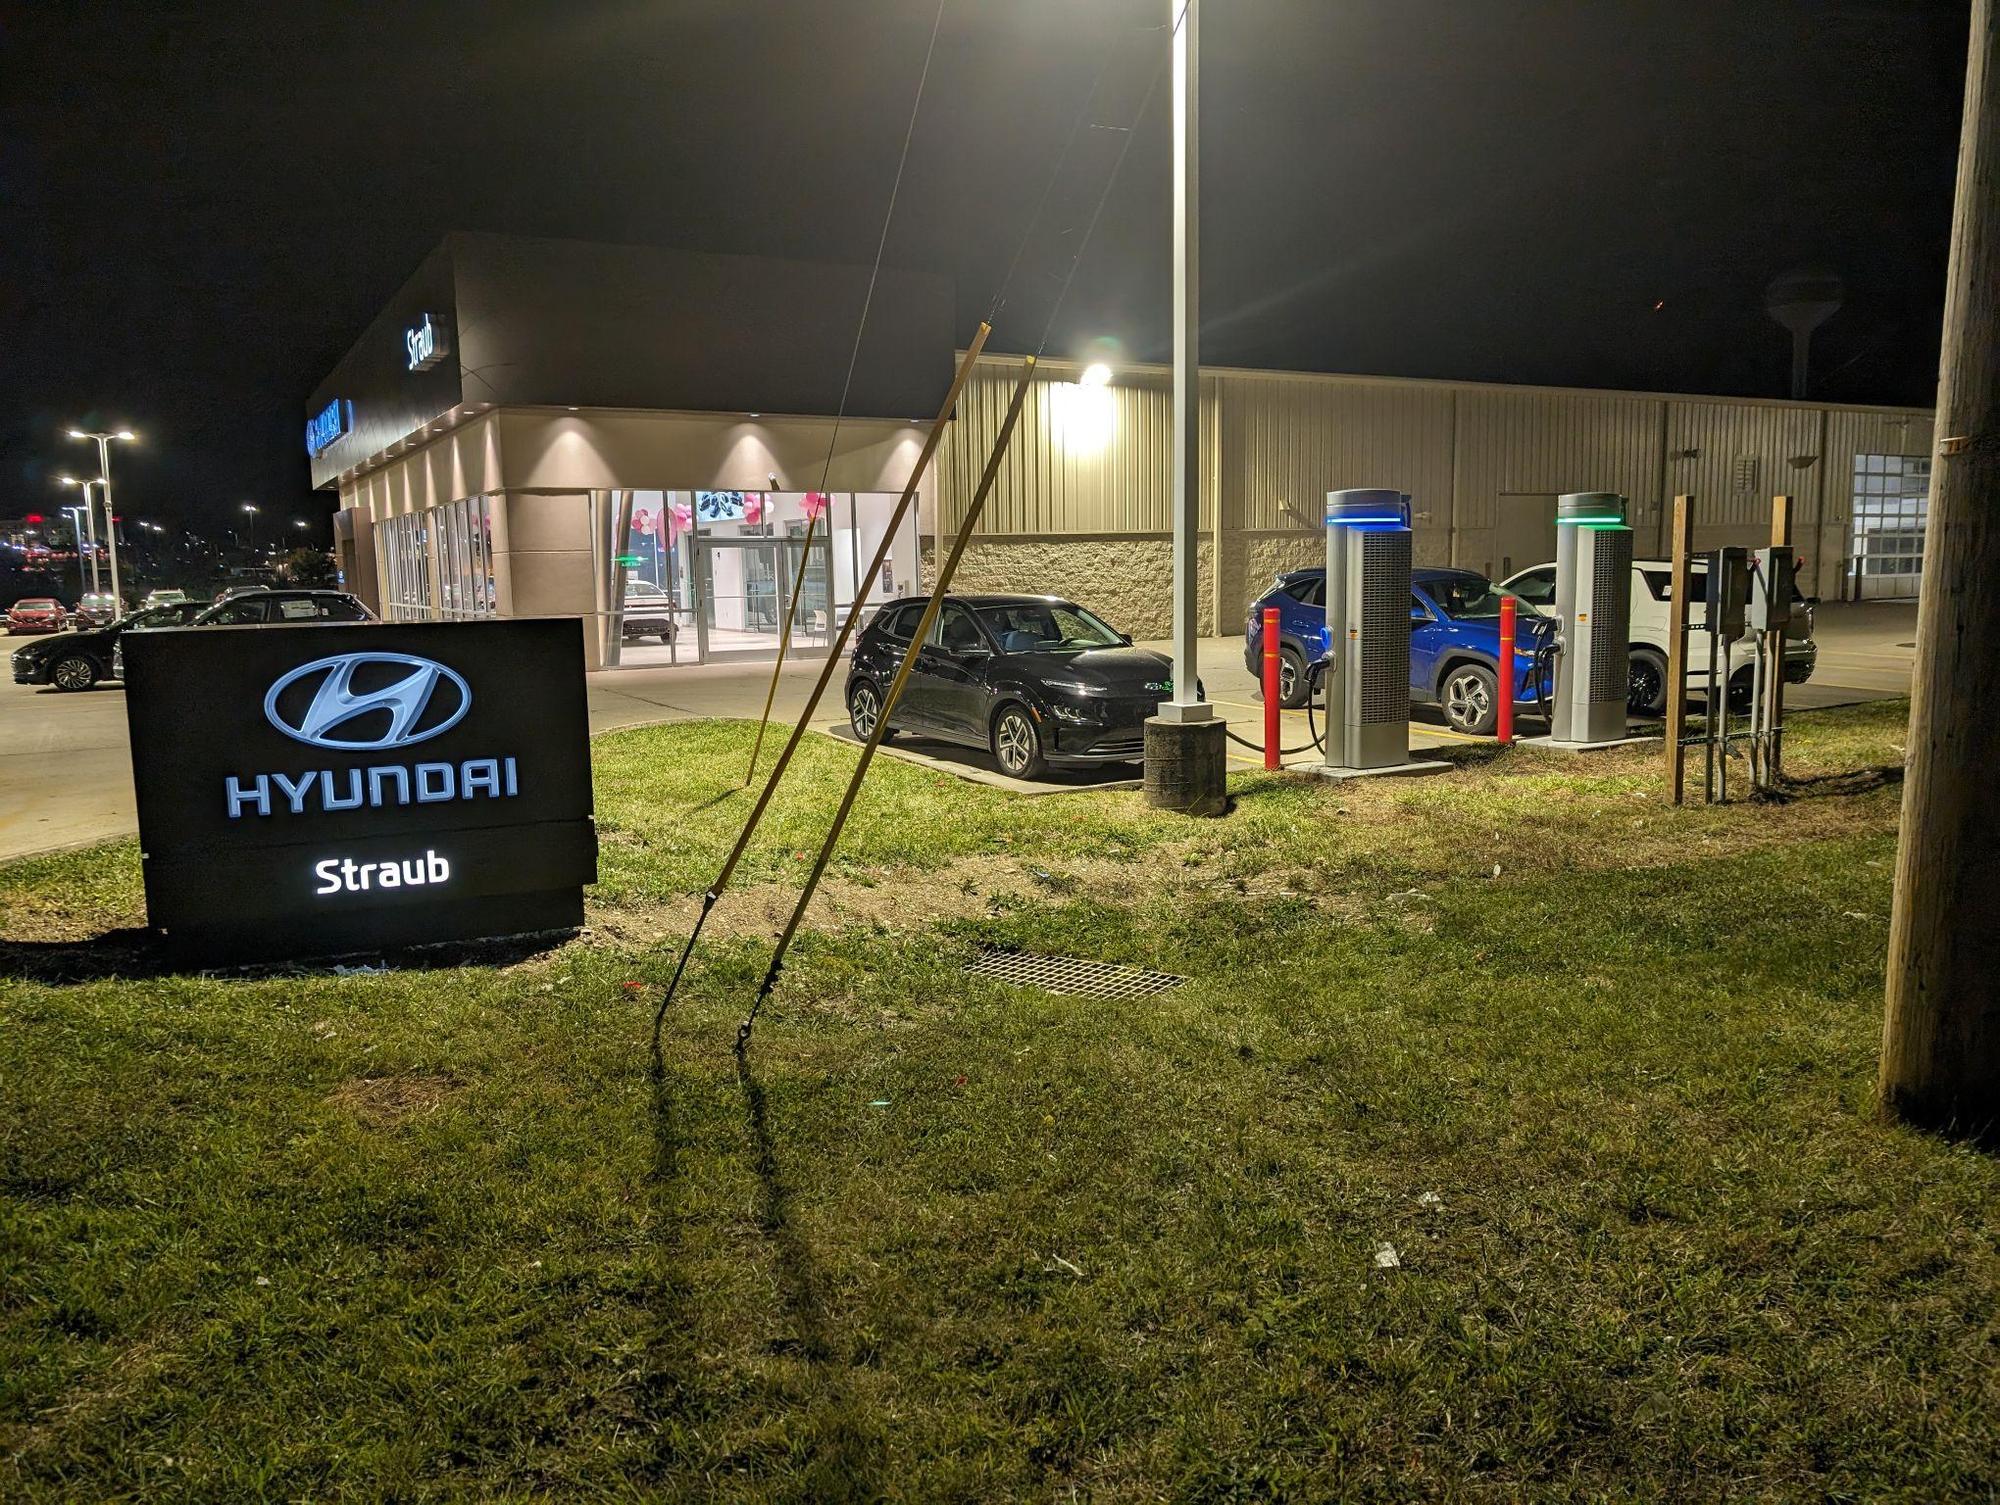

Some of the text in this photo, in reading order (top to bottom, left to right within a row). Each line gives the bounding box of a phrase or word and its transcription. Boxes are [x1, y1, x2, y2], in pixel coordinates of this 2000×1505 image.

[407, 313, 433, 371] Straub
[226, 757, 518, 818] HYUNDAI
[314, 850, 450, 894] Straub
